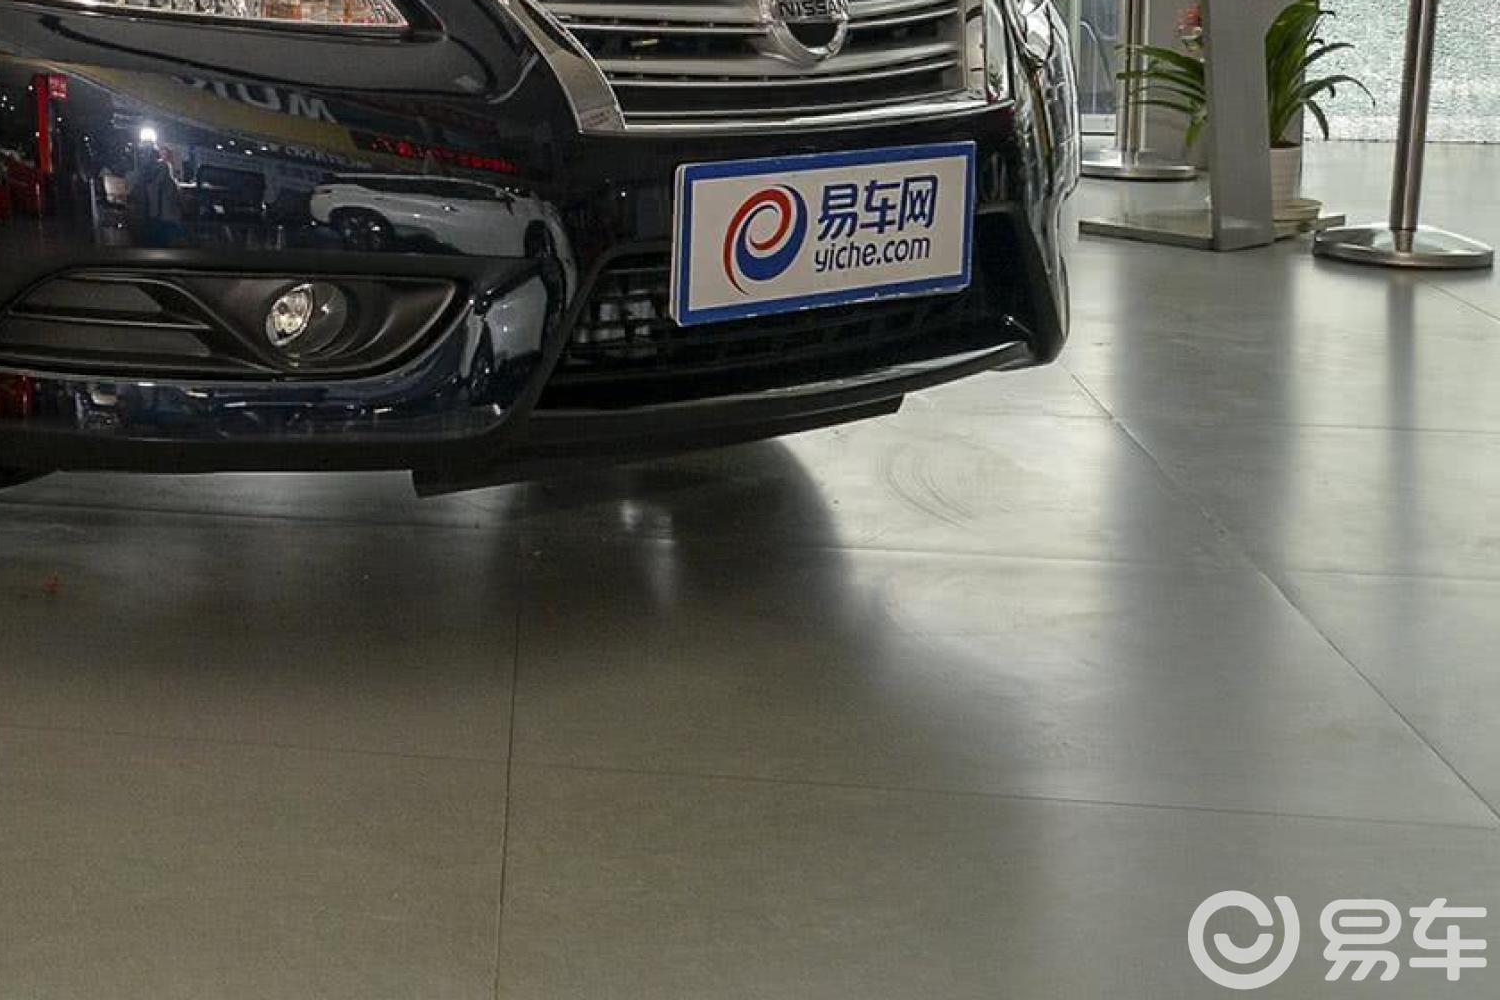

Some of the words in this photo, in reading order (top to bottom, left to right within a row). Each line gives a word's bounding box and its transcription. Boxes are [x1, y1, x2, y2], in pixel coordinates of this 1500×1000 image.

[817, 175, 938, 241] 易车网
[814, 237, 931, 272] yiche.com
